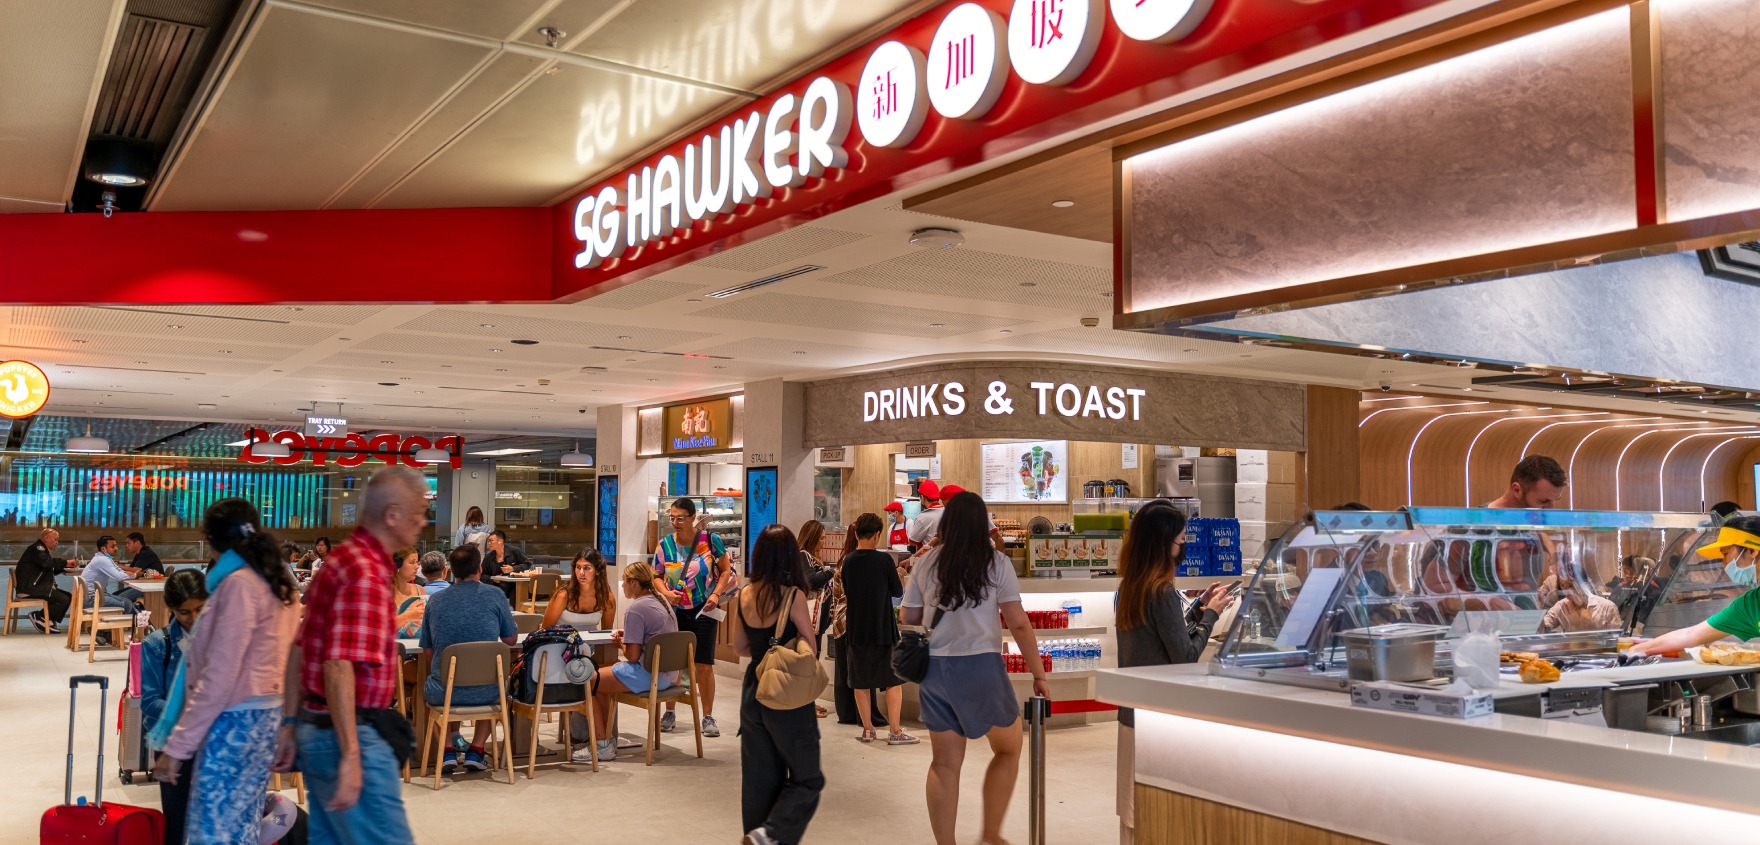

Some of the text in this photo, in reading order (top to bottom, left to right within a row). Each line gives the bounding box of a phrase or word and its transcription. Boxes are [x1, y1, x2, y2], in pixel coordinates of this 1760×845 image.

[574, 76, 840, 269] SG HAWKER
[863, 380, 1147, 423] DRINKS & TOAST
[308, 417, 347, 426] TRAY RETURN
[910, 446, 930, 455] ORDER
[750, 453, 774, 464] STALL 11
